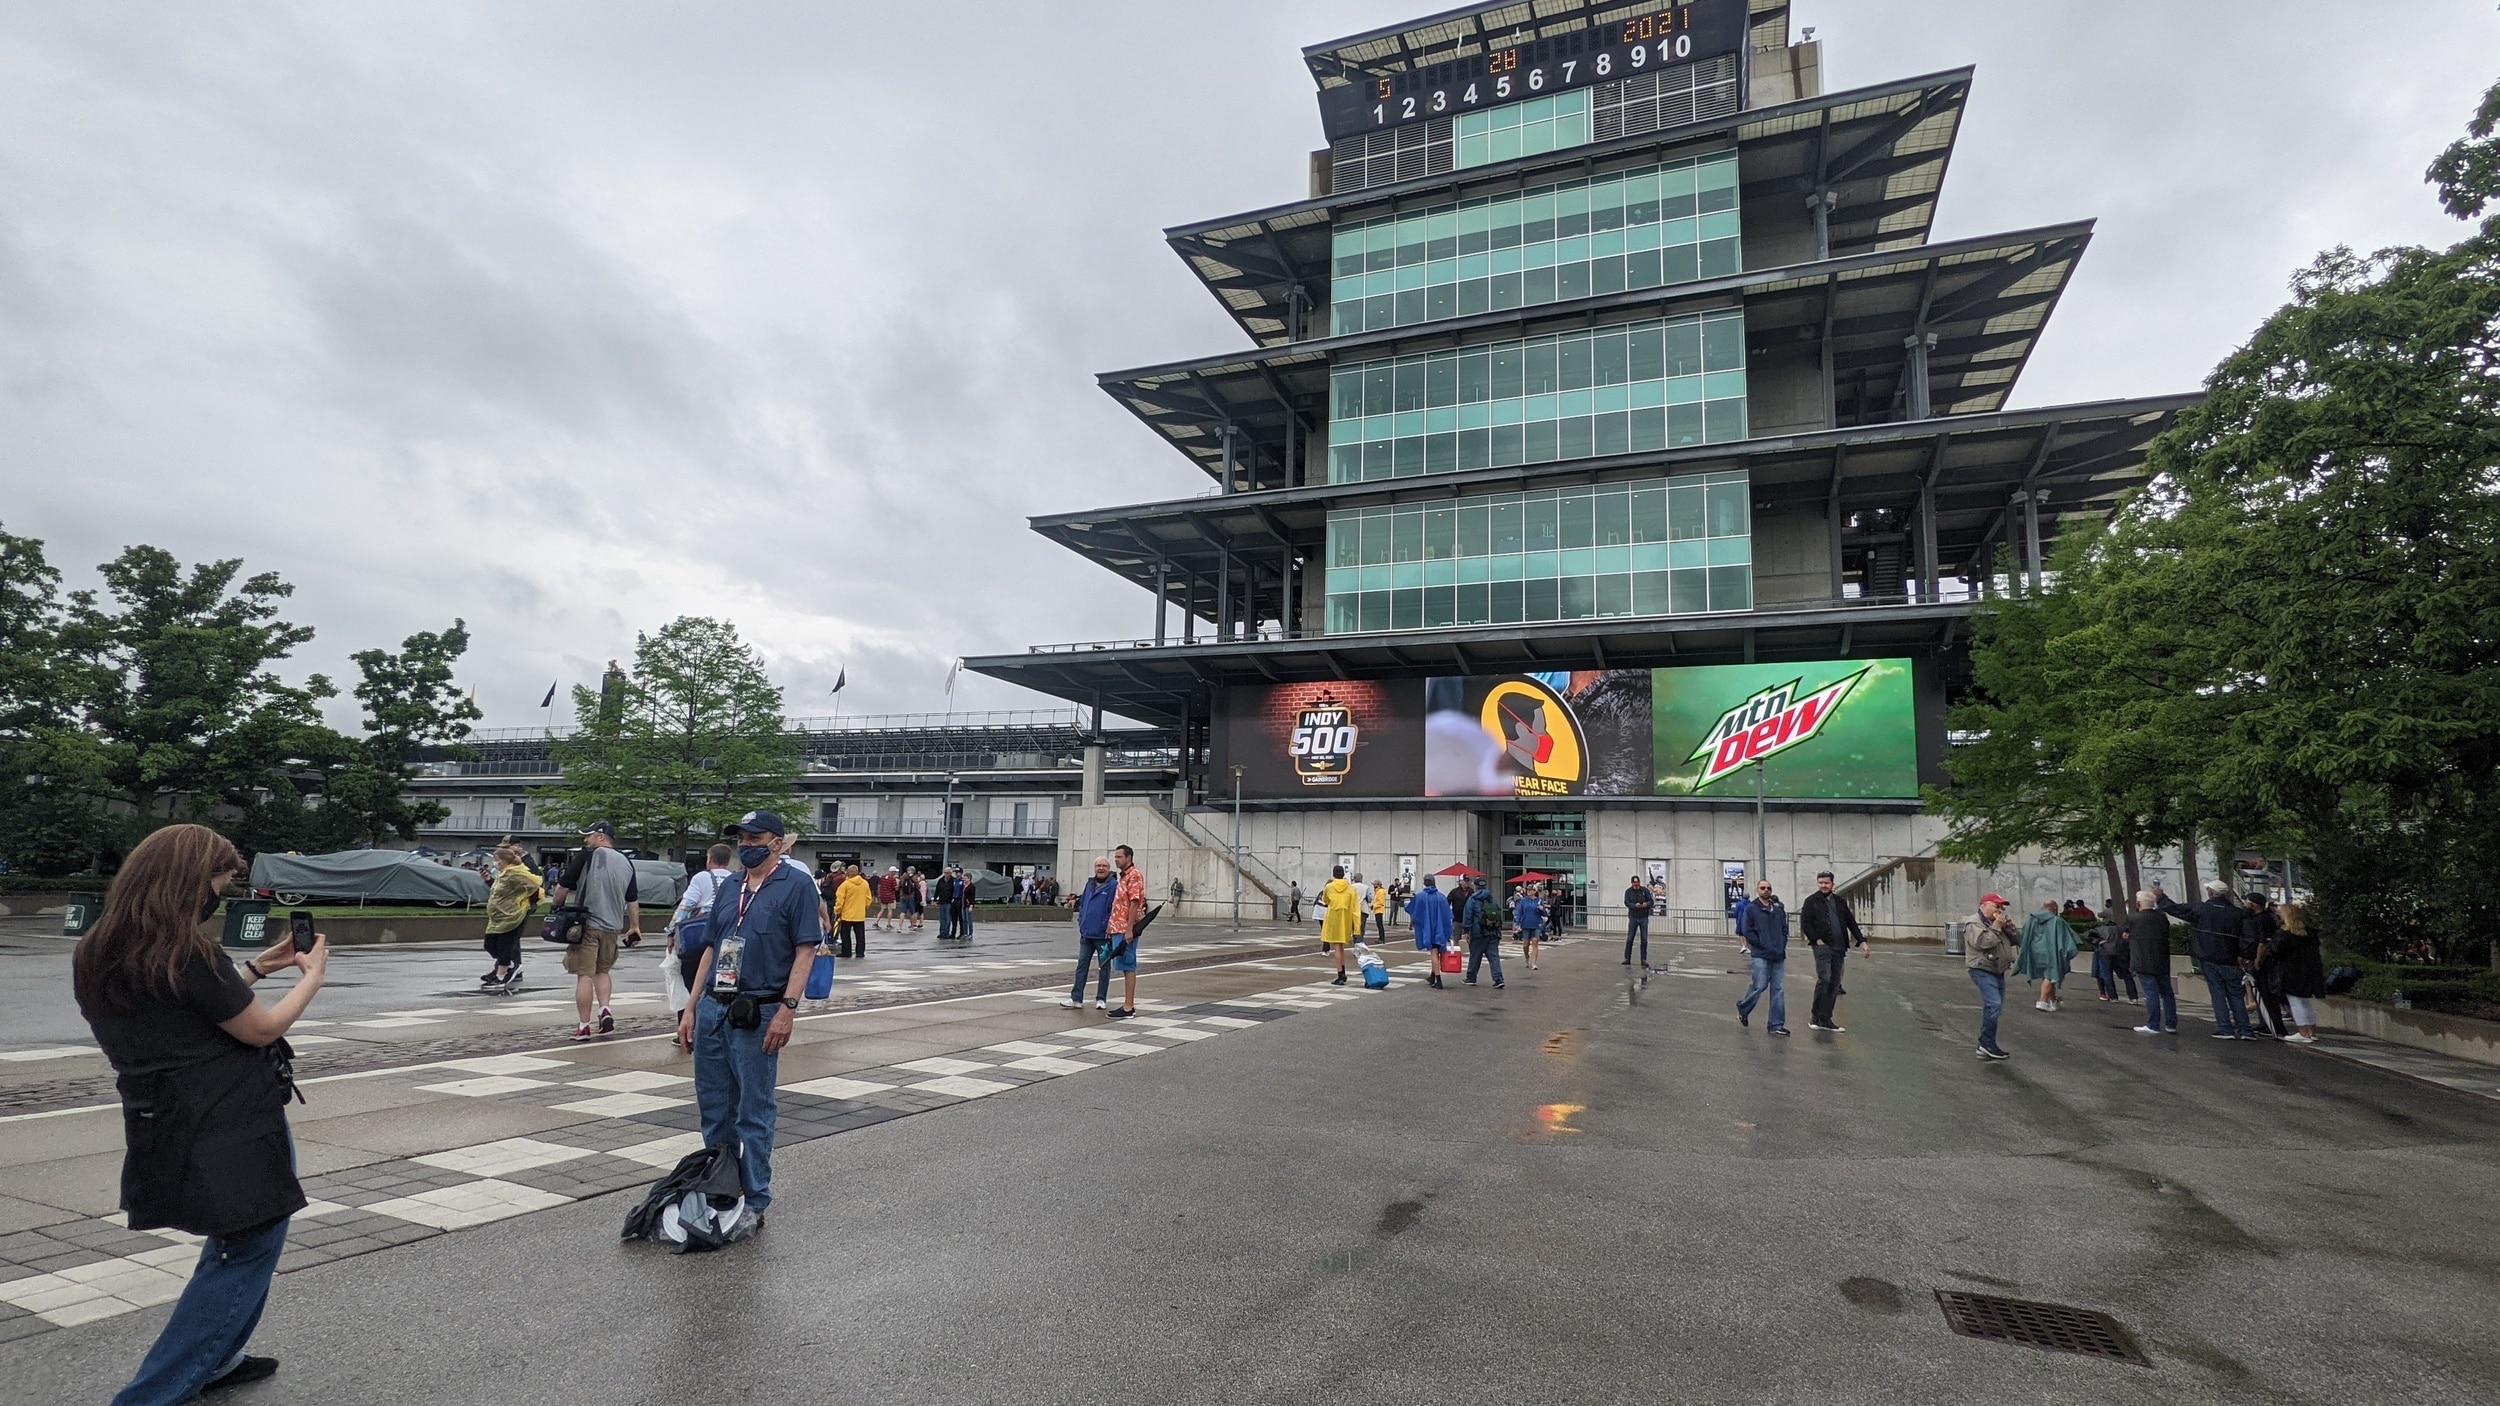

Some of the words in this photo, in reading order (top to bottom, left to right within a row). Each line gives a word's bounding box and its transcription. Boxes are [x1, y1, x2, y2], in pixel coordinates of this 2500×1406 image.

[1489, 48, 1517, 74] 28
[1623, 7, 1688, 43] 2021
[1373, 103, 1384, 125] 1
[1401, 97, 1416, 119] 2
[1432, 90, 1447, 112] 3
[1463, 83, 1479, 104] 4
[1496, 75, 1511, 98] 5
[1528, 68, 1544, 90] 6
[1562, 60, 1577, 83] 7
[1596, 53, 1611, 75] 8
[1630, 45, 1646, 68] 9
[1657, 35, 1691, 61] 10
[1304, 711, 1343, 726] INDY
[1290, 726, 1356, 755] 500
[1540, 779, 1569, 794] FACE
[1528, 839, 1560, 847] PAGODA
[247, 915, 266, 923] KEEP
[245, 923, 265, 931] INDY
